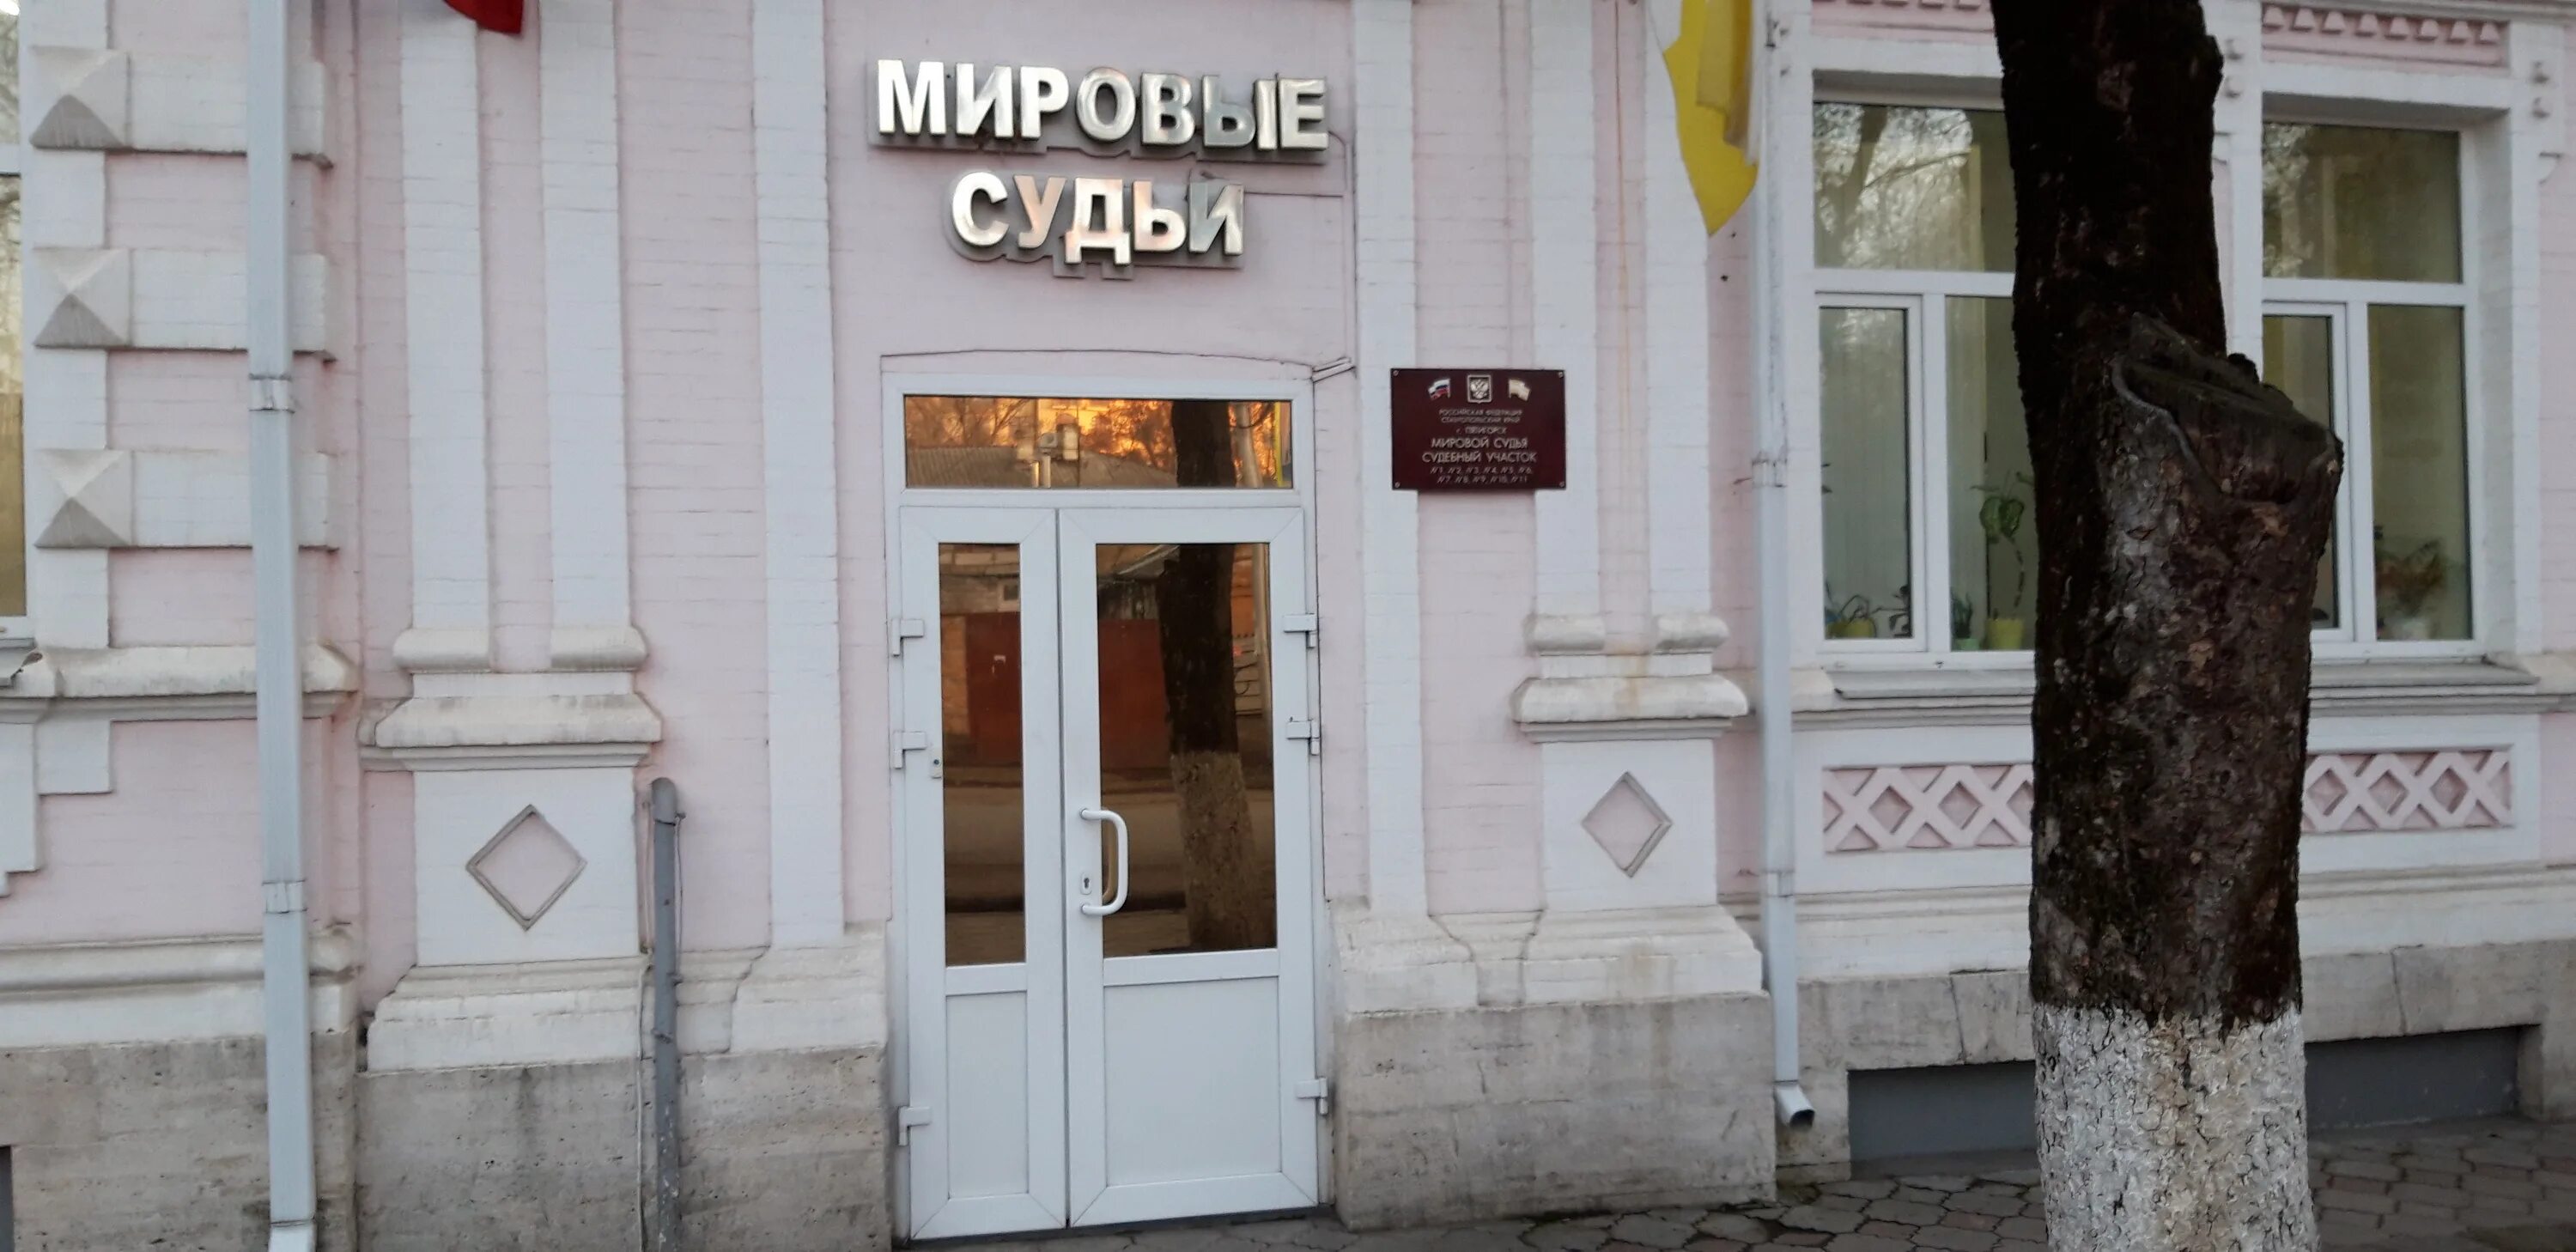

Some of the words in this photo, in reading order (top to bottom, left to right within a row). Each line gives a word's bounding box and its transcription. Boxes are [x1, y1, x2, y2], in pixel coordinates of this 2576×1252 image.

[877, 58, 1330, 150] МИРОВЫЕ
[951, 171, 1244, 265] СУДЬИ
[1422, 451, 1481, 463] СУДЕБНЫЙ
[1485, 452, 1537, 463] УЧАСТОК
[1431, 436, 1489, 448] МИРОВОЙ
[1493, 437, 1528, 448] СУДЬЯ
